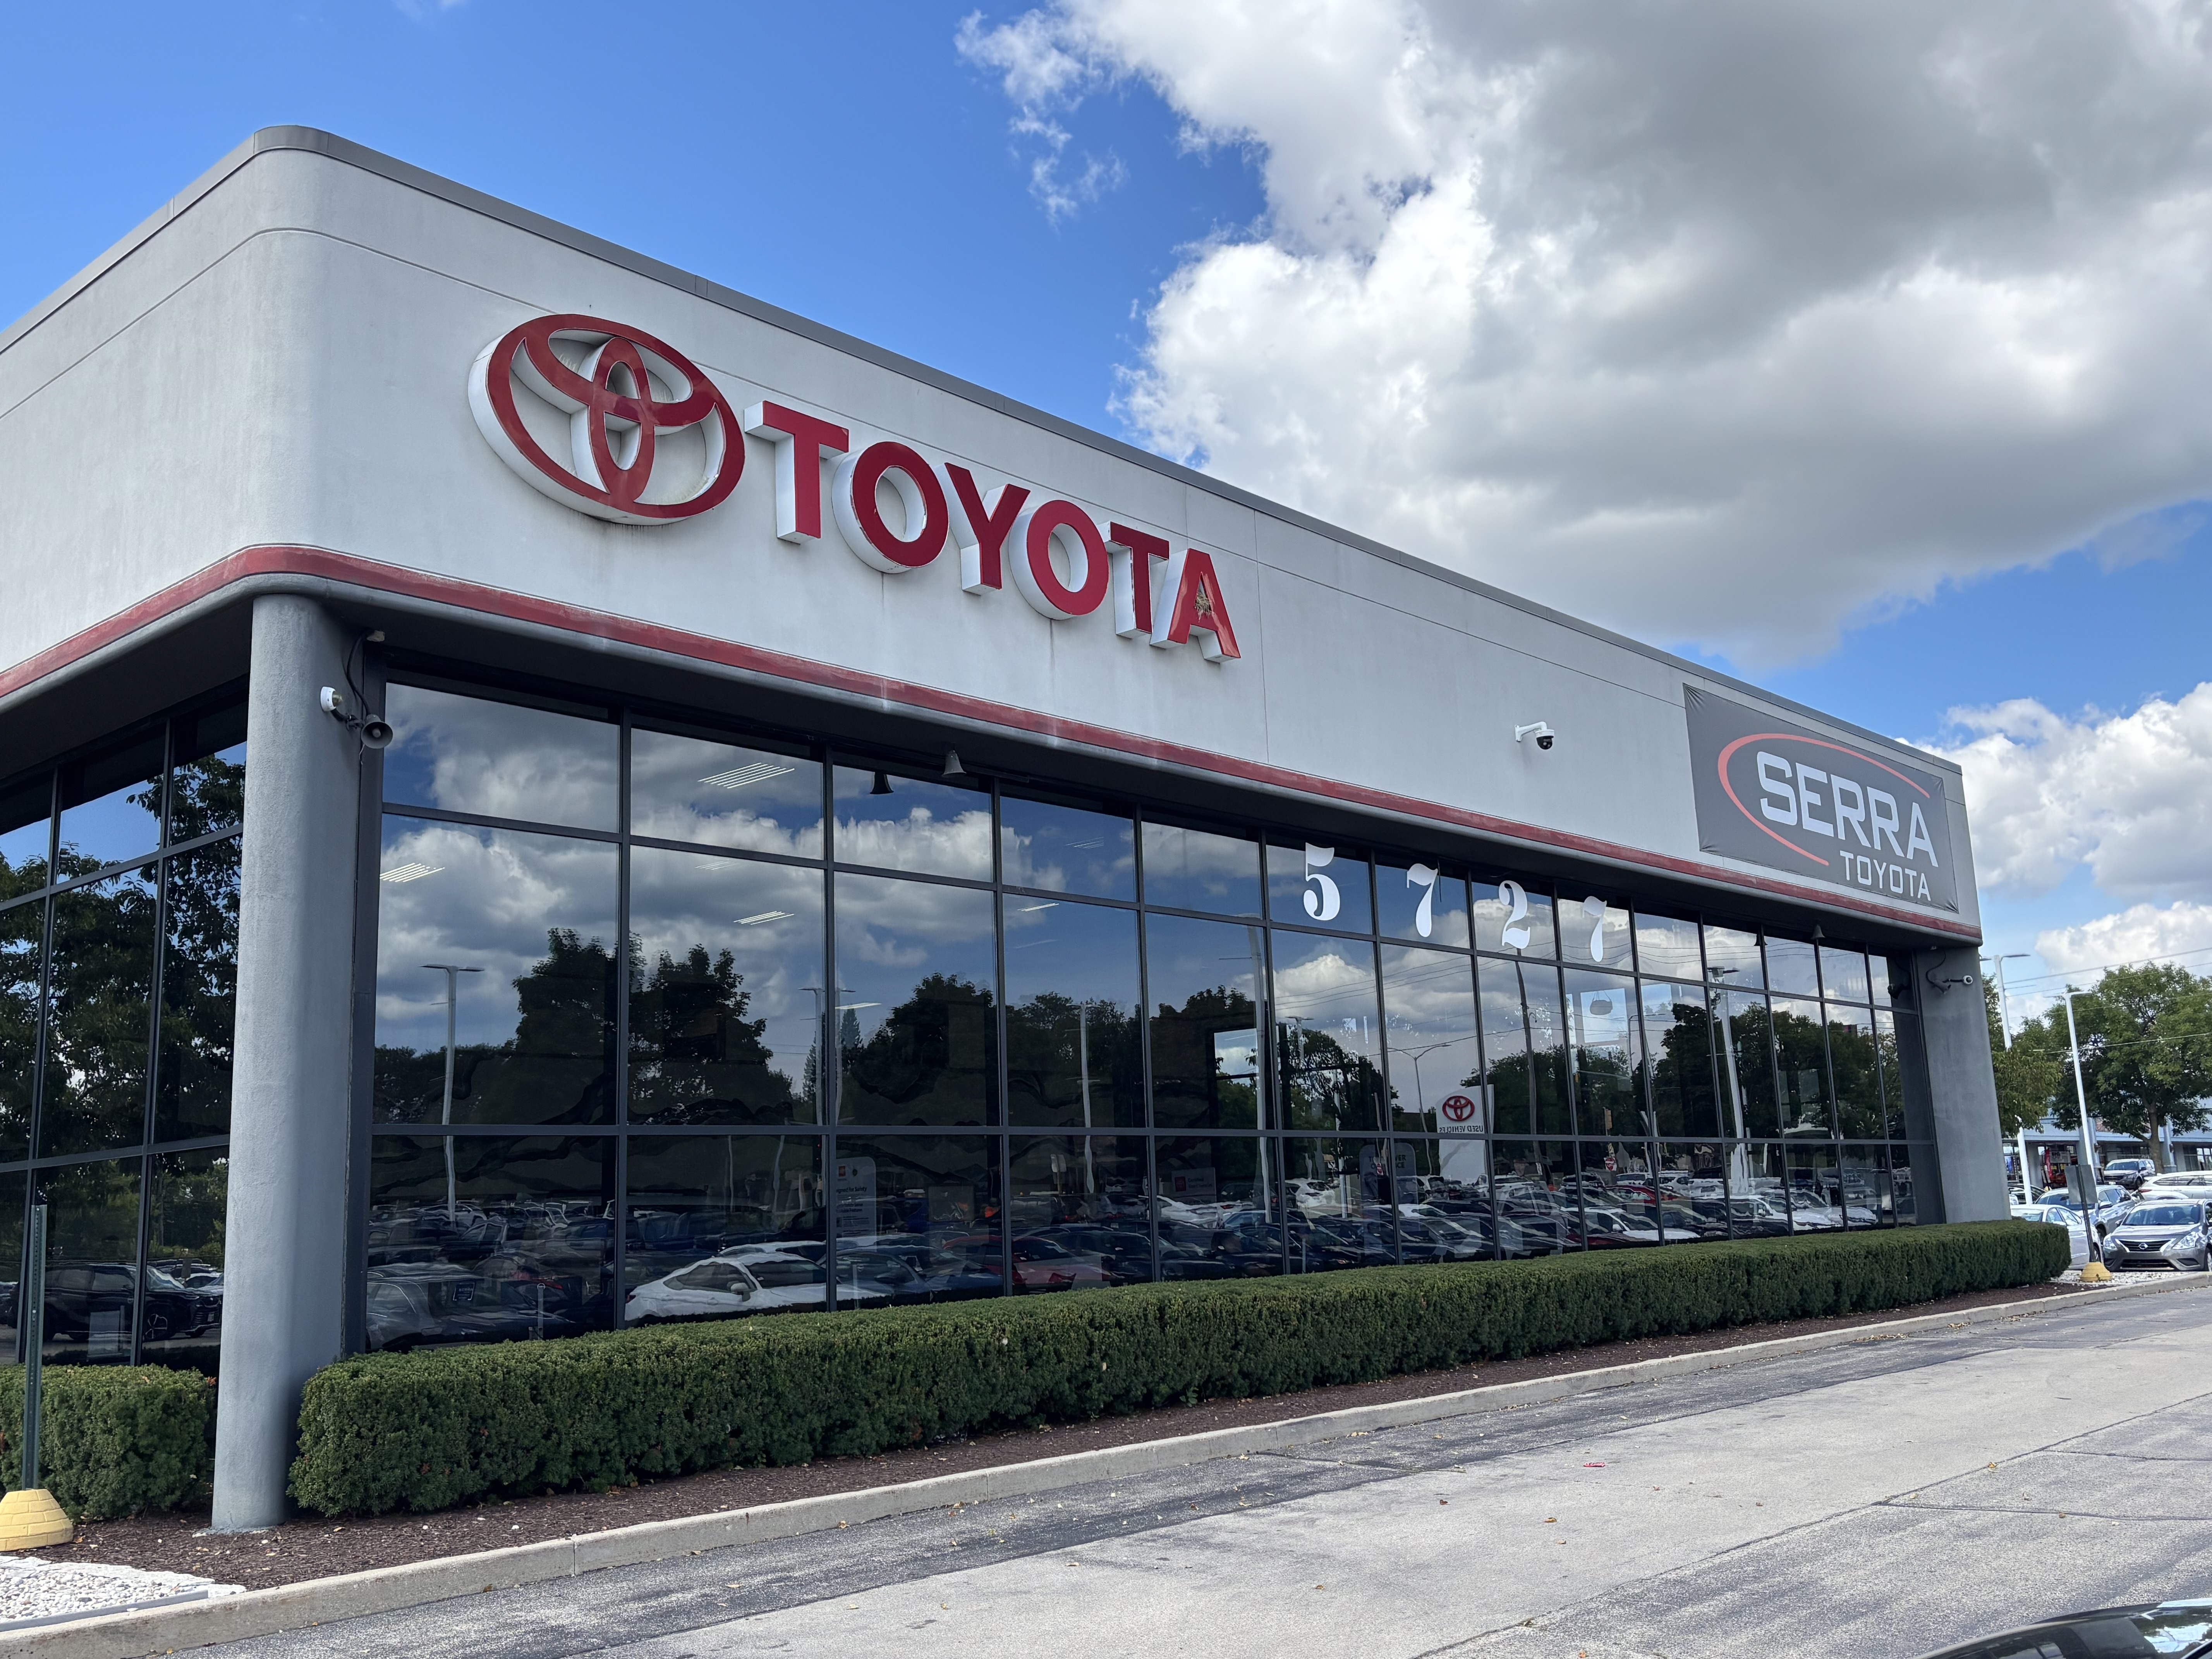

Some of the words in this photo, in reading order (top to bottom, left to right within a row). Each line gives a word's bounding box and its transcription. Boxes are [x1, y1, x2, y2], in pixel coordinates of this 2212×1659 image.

[762, 400, 1241, 660] TOYOTA
[1756, 751, 1939, 868] SERRA
[1839, 850, 1931, 902] TOYOTA
